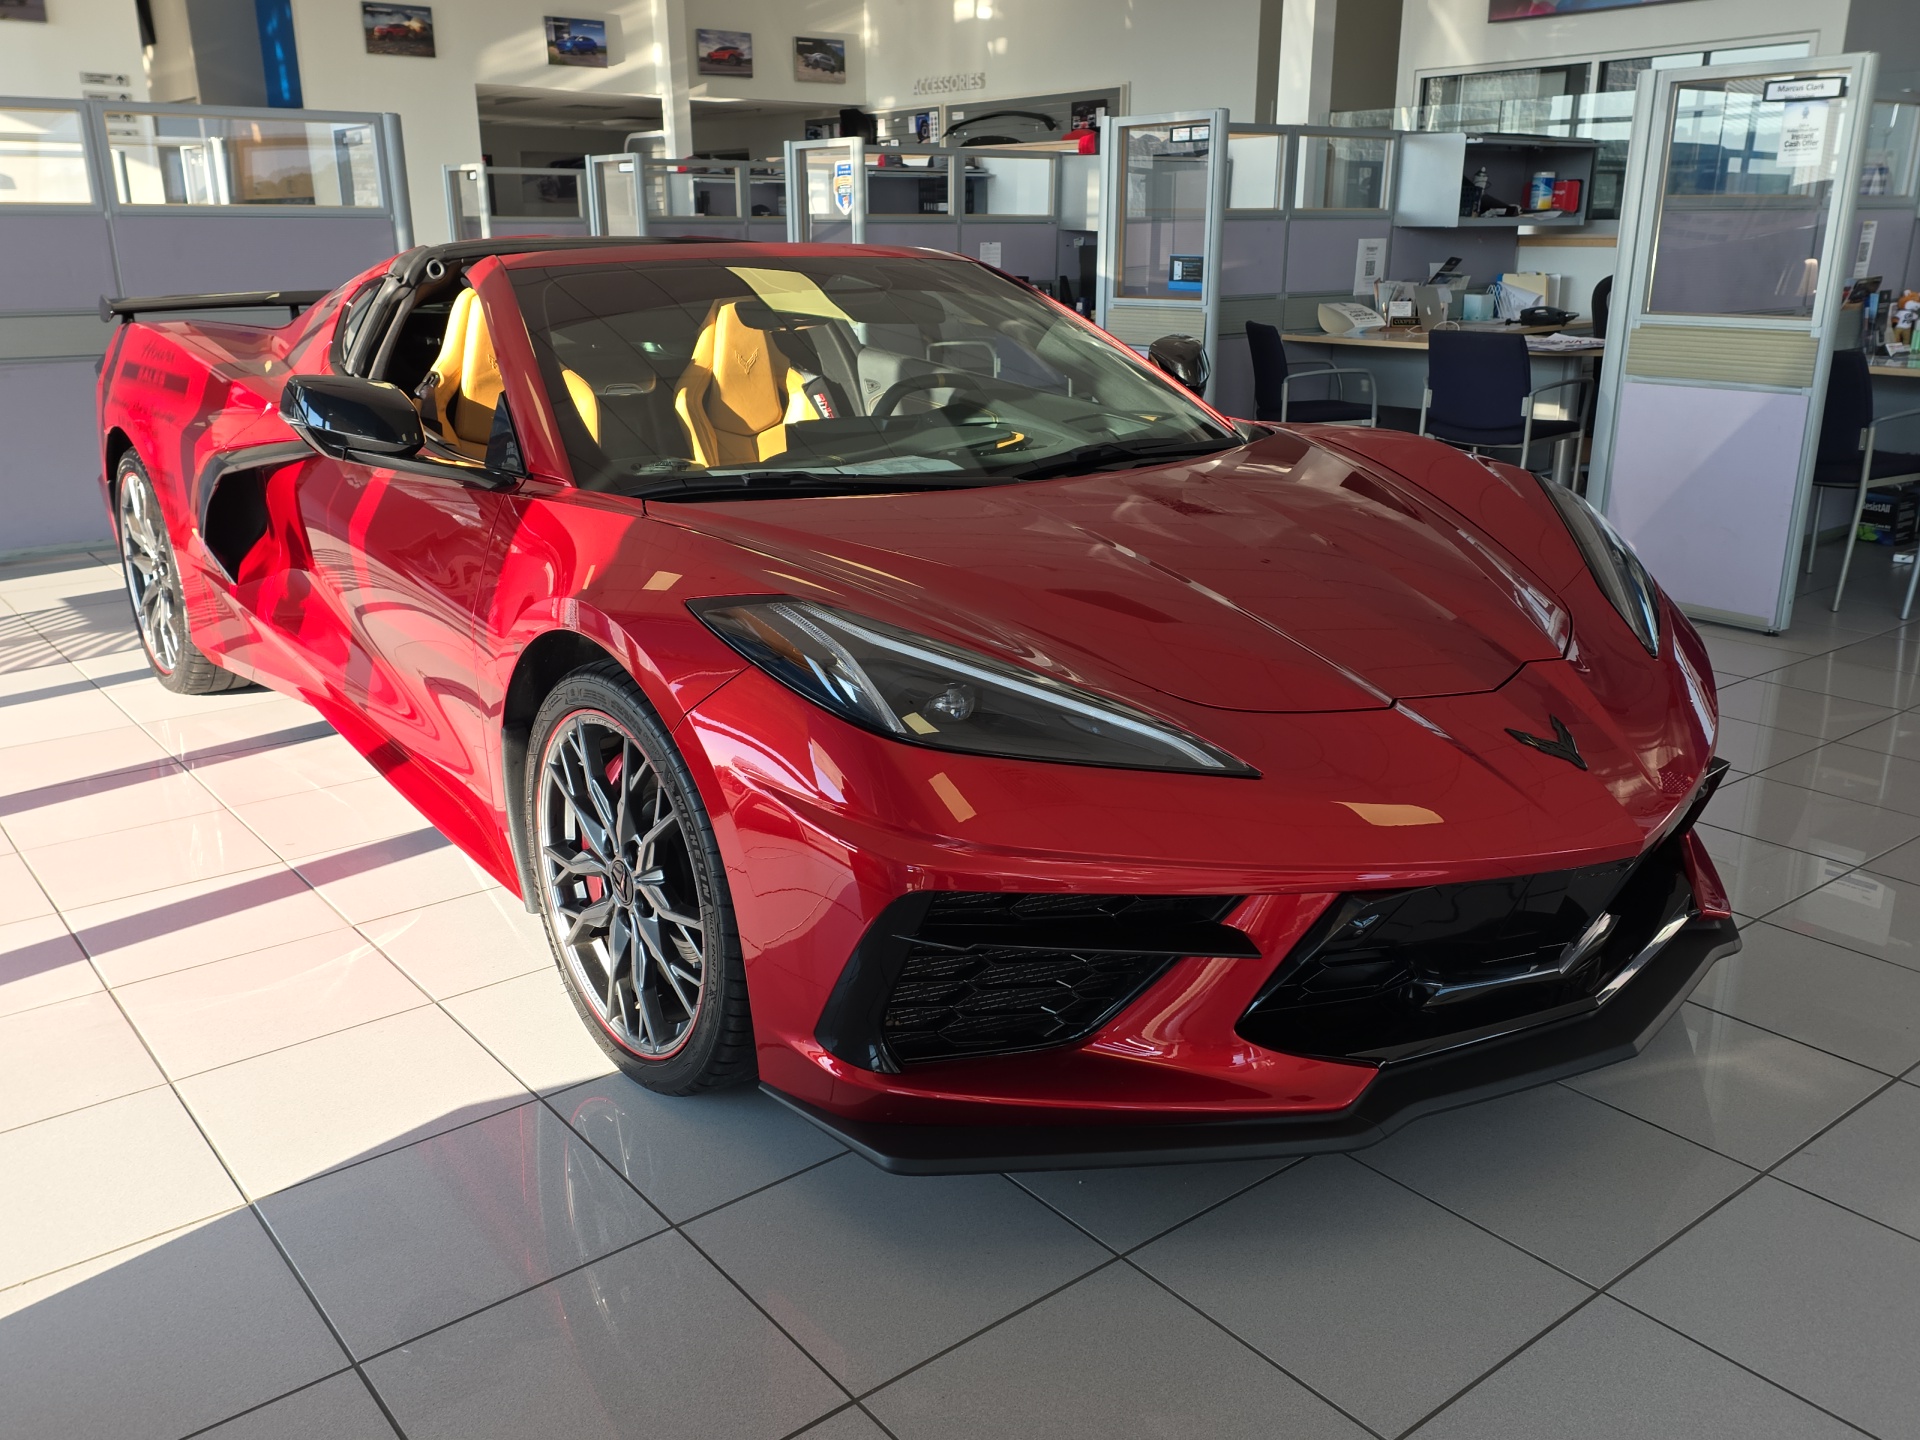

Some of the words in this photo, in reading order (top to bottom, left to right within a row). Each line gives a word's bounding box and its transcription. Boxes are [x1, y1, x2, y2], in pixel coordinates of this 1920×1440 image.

[913, 72, 985, 95] ACCESSORIES
[1777, 84, 1804, 93] Marcus
[1806, 83, 1825, 91] Clark
[1784, 140, 1800, 148] Cash
[675, 795, 711, 898] MICHELIN
